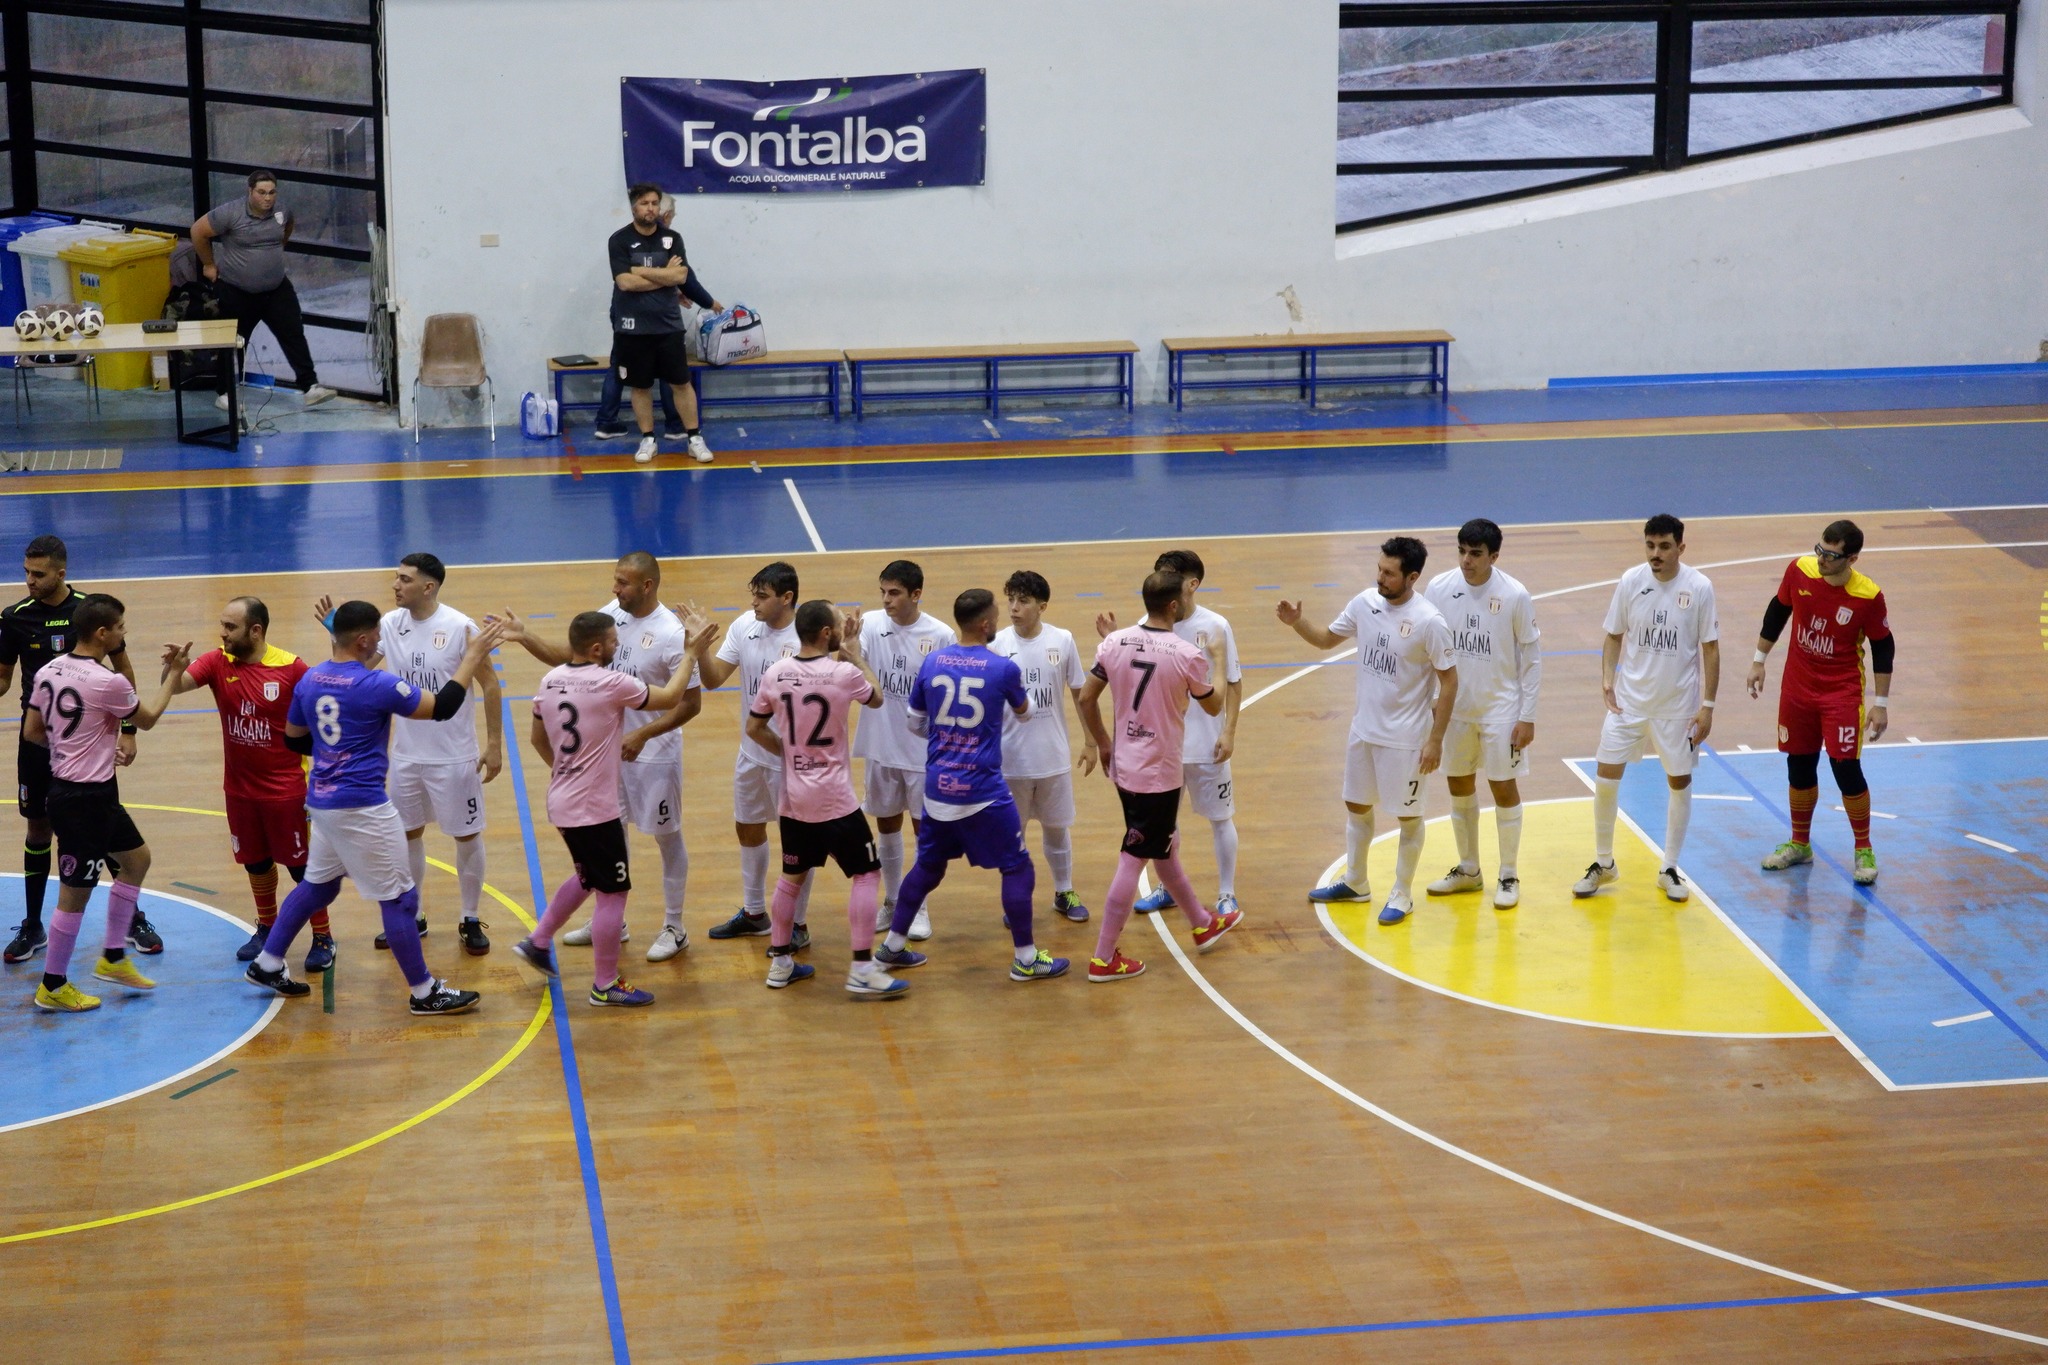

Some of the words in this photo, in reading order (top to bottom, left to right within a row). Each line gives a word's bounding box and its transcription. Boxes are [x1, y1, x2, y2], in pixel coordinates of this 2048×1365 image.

[683, 116, 927, 168] Fontalba
[729, 175, 762, 184] ACQUA
[763, 173, 837, 183] OLIGOMINERALE
[839, 171, 886, 181] NATURALE
[727, 345, 760, 359] macron
[45, 619, 70, 627] LEGEA
[1453, 630, 1491, 655] LAGANÀ
[1638, 626, 1678, 651] LAGANÀ
[1363, 645, 1398, 676] LAGANÀ
[1130, 659, 1157, 713] 7
[40, 680, 85, 740] 29
[931, 674, 985, 728] 25
[227, 714, 271, 741] LAGANÀ
[315, 694, 342, 746] 8
[558, 701, 581, 754] 3
[780, 691, 835, 747] 12
[1838, 726, 1856, 744] 12
[1408, 780, 1419, 796] 7
[467, 797, 478, 815] 9
[658, 799, 669, 816] 6
[294, 831, 302, 848] 1
[615, 861, 627, 883] 3
